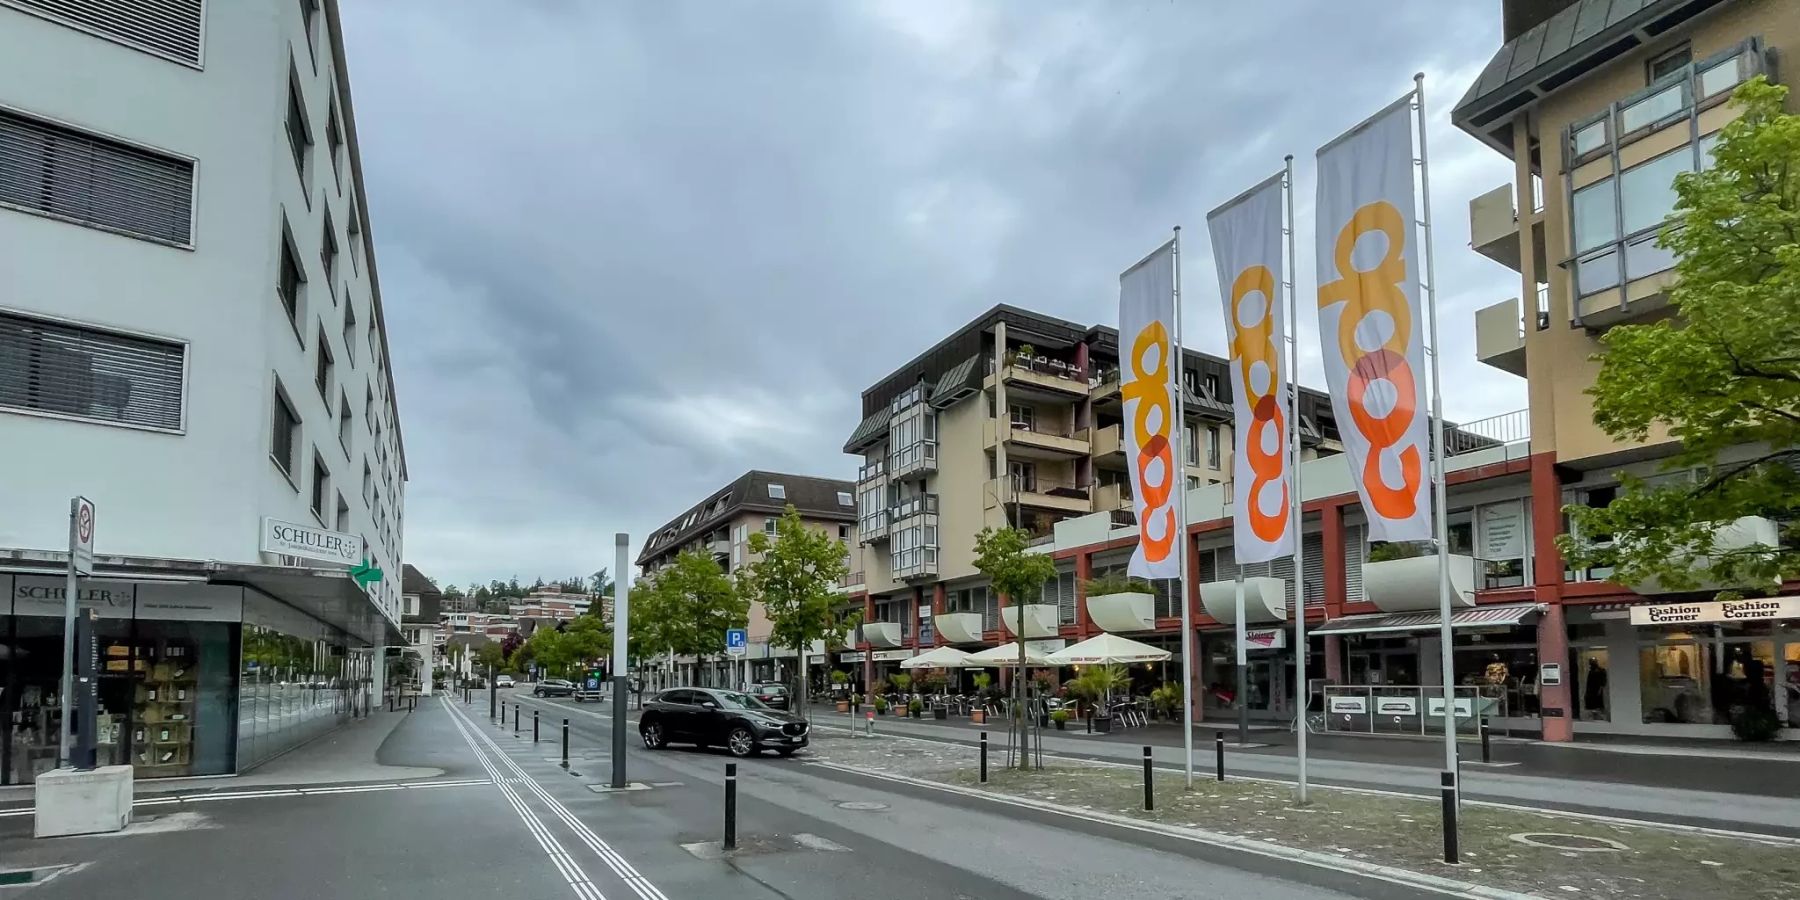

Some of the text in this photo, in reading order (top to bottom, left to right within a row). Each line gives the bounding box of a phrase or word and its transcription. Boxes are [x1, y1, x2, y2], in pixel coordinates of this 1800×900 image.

[273, 525, 345, 557] SCHULER
[1648, 606, 1700, 616] Fashion
[1722, 601, 1780, 612] Fashion
[1650, 613, 1699, 622] Corner
[1723, 609, 1777, 619] Corner
[732, 632, 741, 645] P
